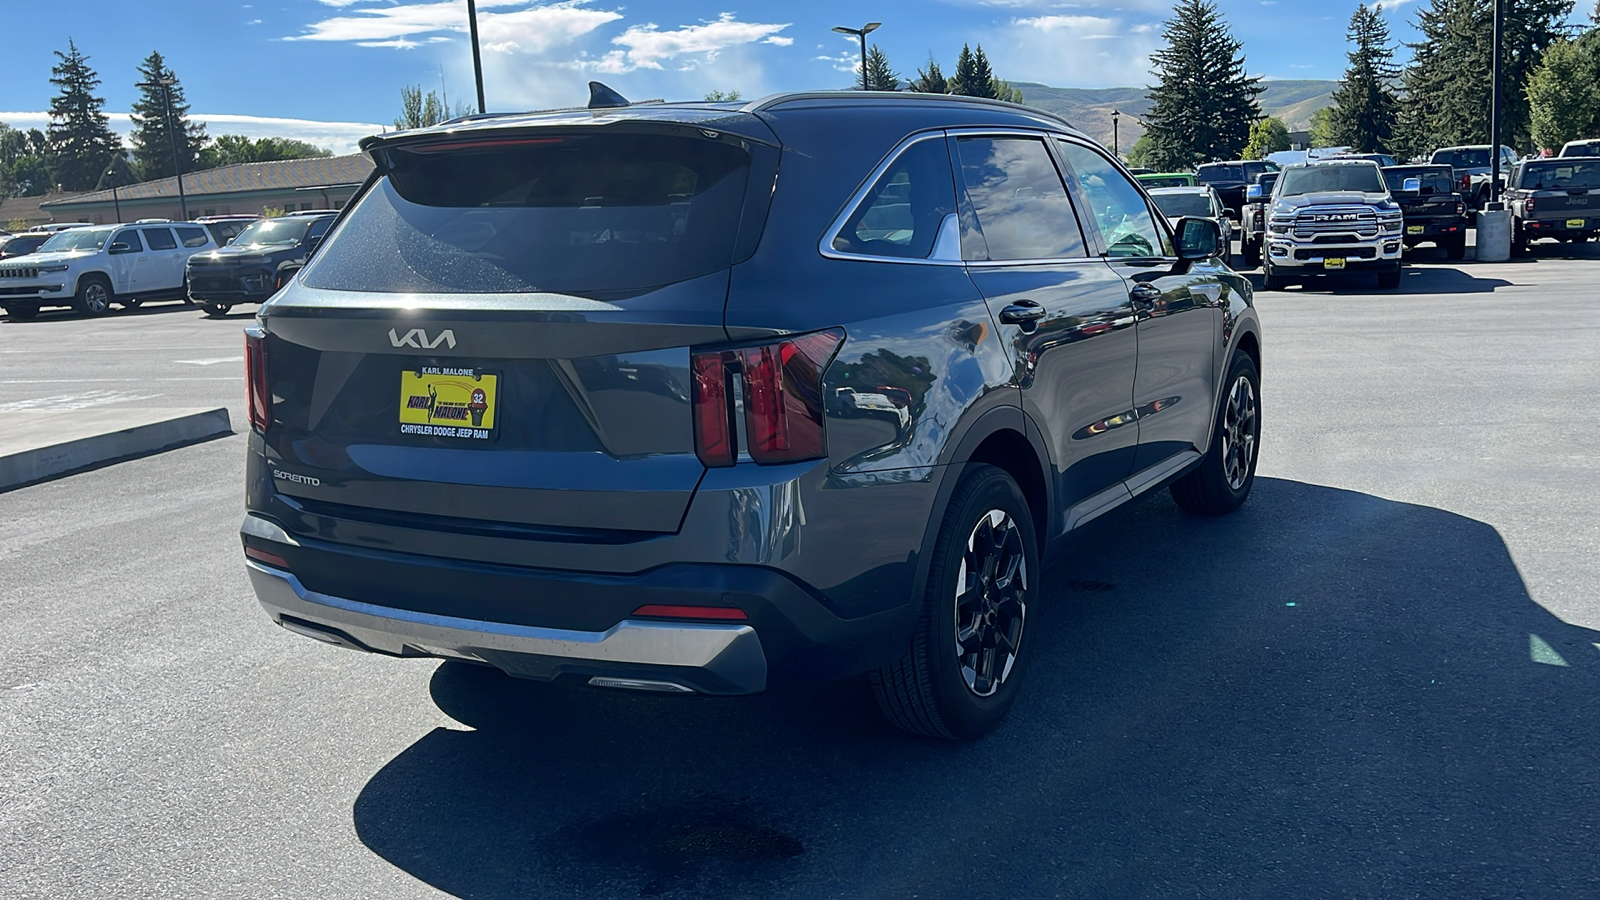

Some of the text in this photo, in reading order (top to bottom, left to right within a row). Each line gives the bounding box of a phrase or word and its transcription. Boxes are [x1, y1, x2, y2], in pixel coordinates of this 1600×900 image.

[1565, 196, 1588, 205] Jeep
[388, 327, 457, 350] KIA
[421, 366, 474, 376] KARL MALONE
[406, 395, 431, 409] KARL
[473, 393, 484, 404] 32
[433, 405, 469, 420] MALONE
[400, 424, 489, 439] CHRYSLER DODGE JEEP RAM
[273, 469, 320, 487] SORENTO
